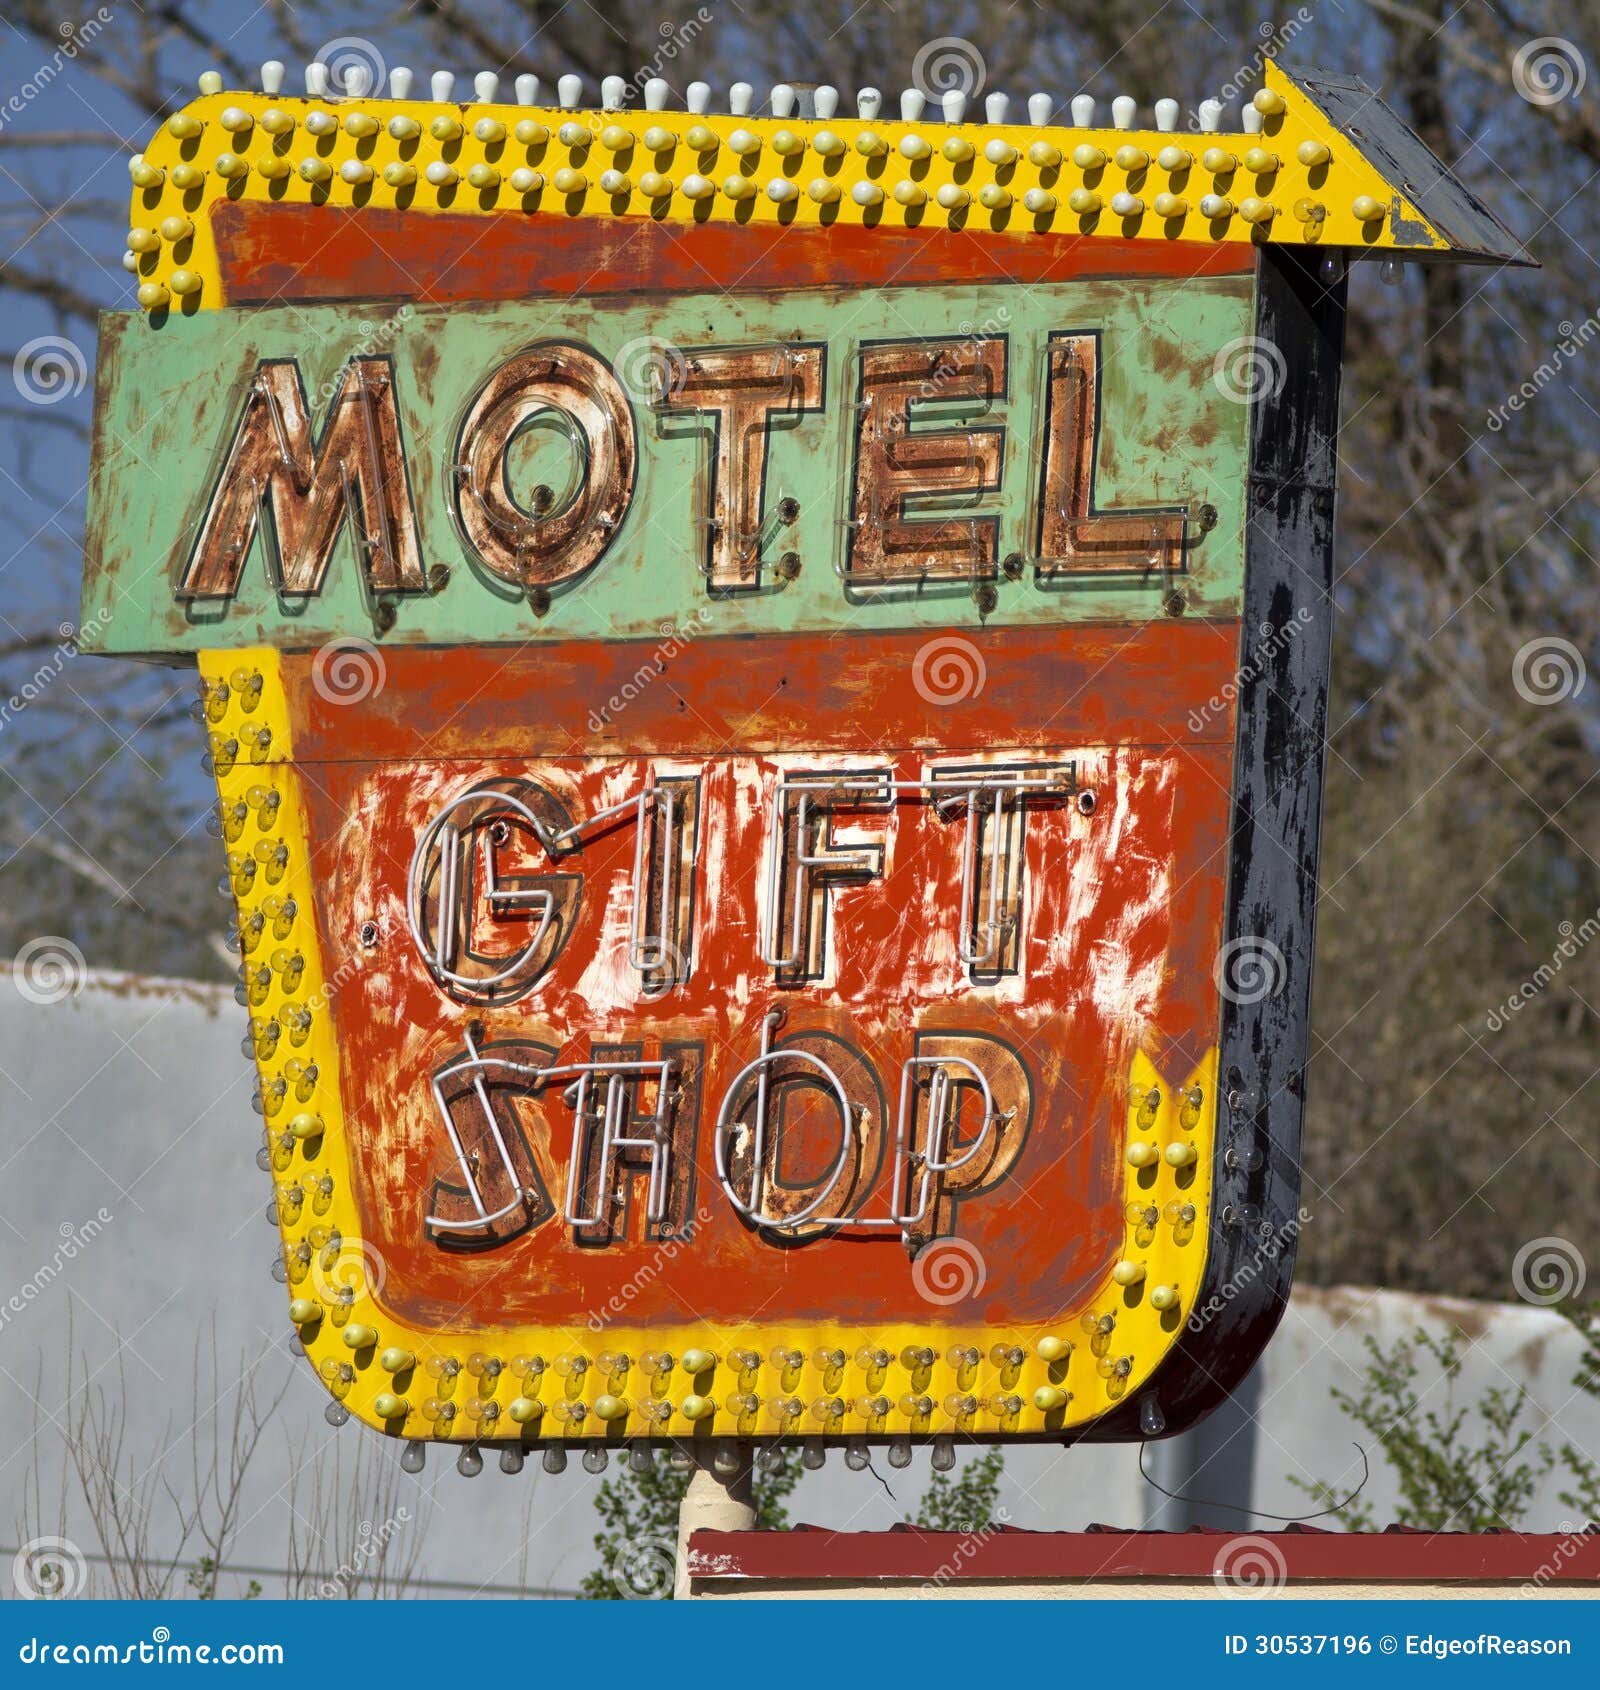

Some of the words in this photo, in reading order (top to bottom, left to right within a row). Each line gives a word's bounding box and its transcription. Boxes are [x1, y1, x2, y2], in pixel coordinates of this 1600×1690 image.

[174, 328, 1194, 602] MOTEL
[408, 761, 1077, 1007] GIFT
[425, 1027, 1035, 1246] SHOP
